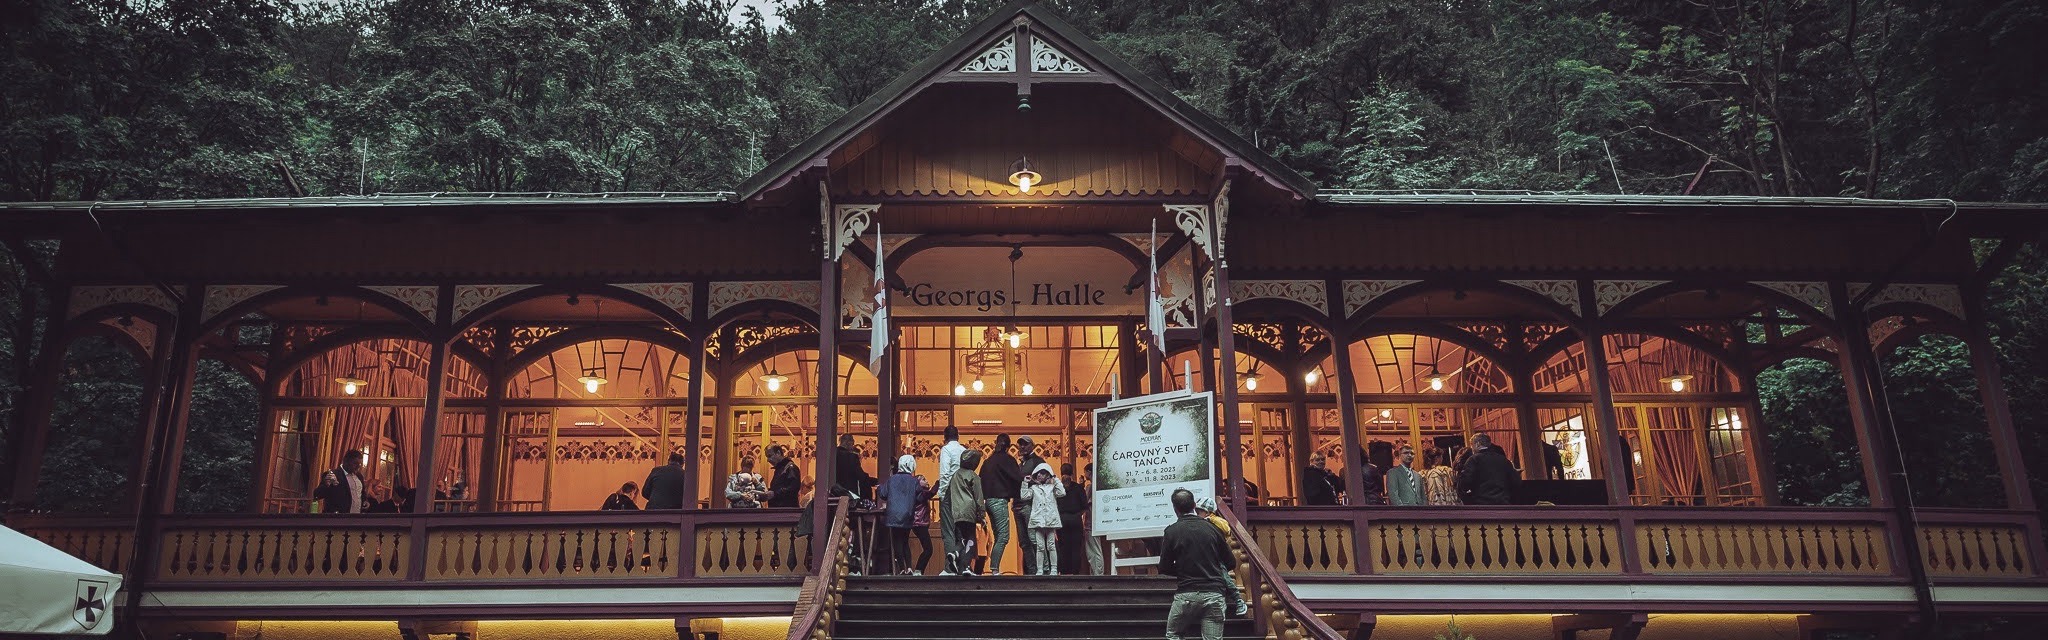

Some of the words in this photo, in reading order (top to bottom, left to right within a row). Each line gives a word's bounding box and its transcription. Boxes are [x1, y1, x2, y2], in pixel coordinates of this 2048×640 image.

[911, 283, 1006, 312] Georgs
[1031, 283, 1105, 306] Halle
[1112, 446, 1161, 461] ČAROVNÝ
[1164, 444, 1190, 455] SVET
[1133, 456, 1168, 467] TANCA
[1160, 473, 1176, 481] 2023
